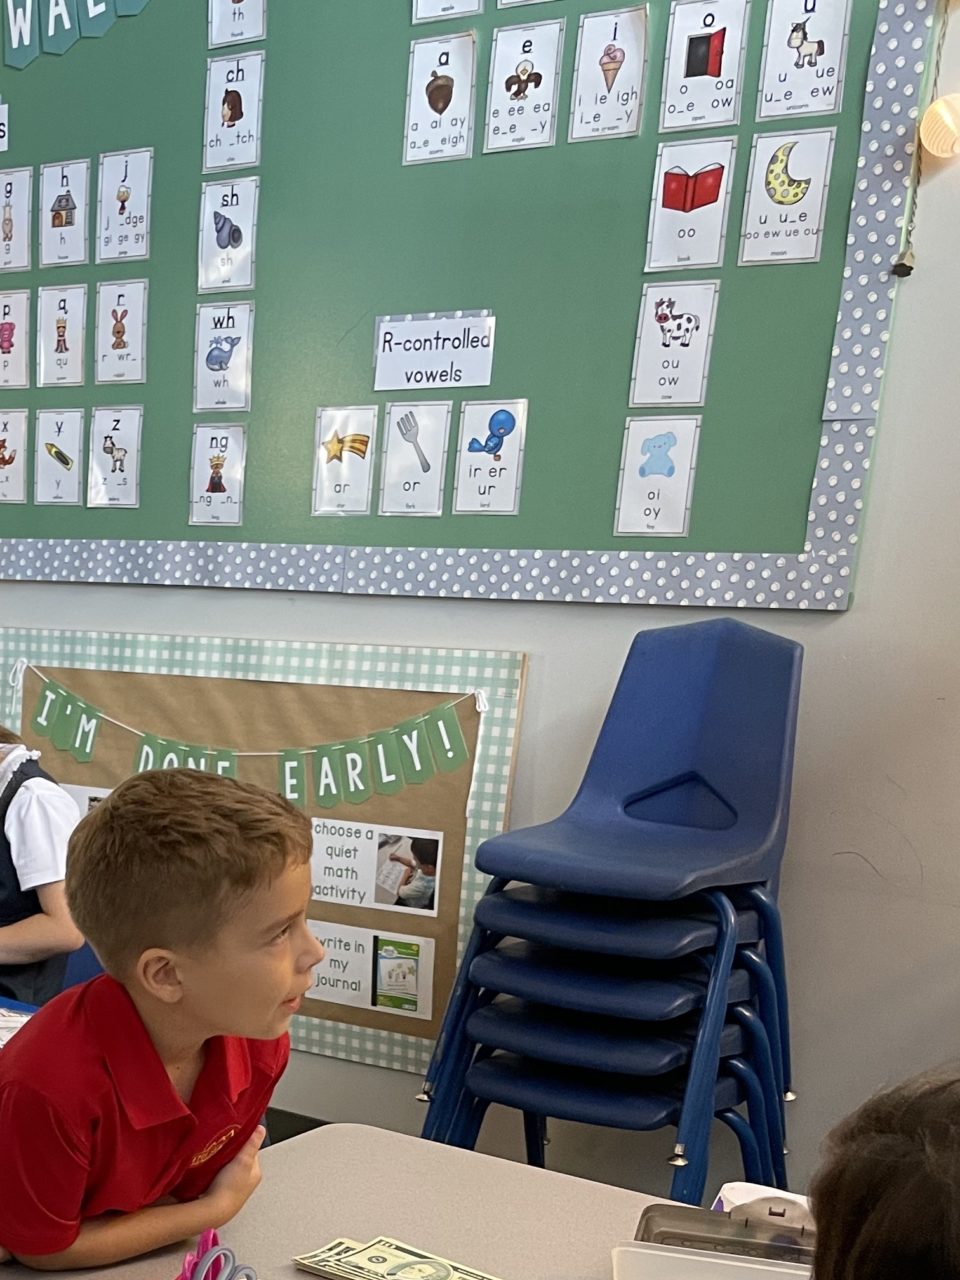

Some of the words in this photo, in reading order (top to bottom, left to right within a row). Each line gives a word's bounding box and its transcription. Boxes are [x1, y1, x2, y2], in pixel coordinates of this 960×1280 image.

[232, 8, 245, 22] th
[703, 13, 715, 28] o
[612, 22, 618, 40] i
[522, 39, 533, 53] e
[439, 51, 449, 66] a
[226, 60, 245, 83] ch
[778, 72, 787, 83] u
[816, 67, 835, 78] ue
[680, 85, 688, 94] o
[715, 79, 734, 90] oa
[811, 86, 834, 98] ew
[617, 86, 638, 106] igh
[711, 97, 733, 109] ow
[508, 105, 524, 116] ee
[533, 102, 550, 114] ea
[450, 116, 466, 129] ay
[209, 132, 221, 148] ch
[441, 134, 465, 147] eigh
[61, 167, 69, 187] h
[121, 160, 128, 183] j
[4, 182, 12, 198] g
[220, 186, 239, 207] sh
[678, 228, 695, 239] oo
[763, 229, 781, 239] ew
[785, 227, 799, 237] ue
[117, 293, 125, 306] r
[2, 304, 10, 320] p
[212, 307, 235, 329] wh
[382, 325, 491, 353] R-controlled
[56, 357, 68, 368] qu
[662, 359, 680, 369] ou
[405, 361, 462, 384] vowels
[213, 374, 229, 388] wh
[658, 376, 679, 386] ow
[209, 435, 229, 453] ng
[468, 465, 482, 478] ir
[488, 466, 507, 478] er
[334, 483, 350, 494] ar
[402, 480, 421, 492] or
[478, 483, 496, 496] ur
[647, 488, 660, 501] oi
[643, 506, 661, 520] oy
[36, 690, 98, 754] I'M
[283, 718, 456, 800] EARLY!
[314, 822, 362, 839] choose
[365, 829, 374, 841] a
[325, 844, 359, 860] quiet
[323, 865, 359, 881] math
[313, 884, 366, 903] activity
[354, 940, 365, 954] in
[329, 958, 349, 973] my
[315, 973, 361, 992] journal
